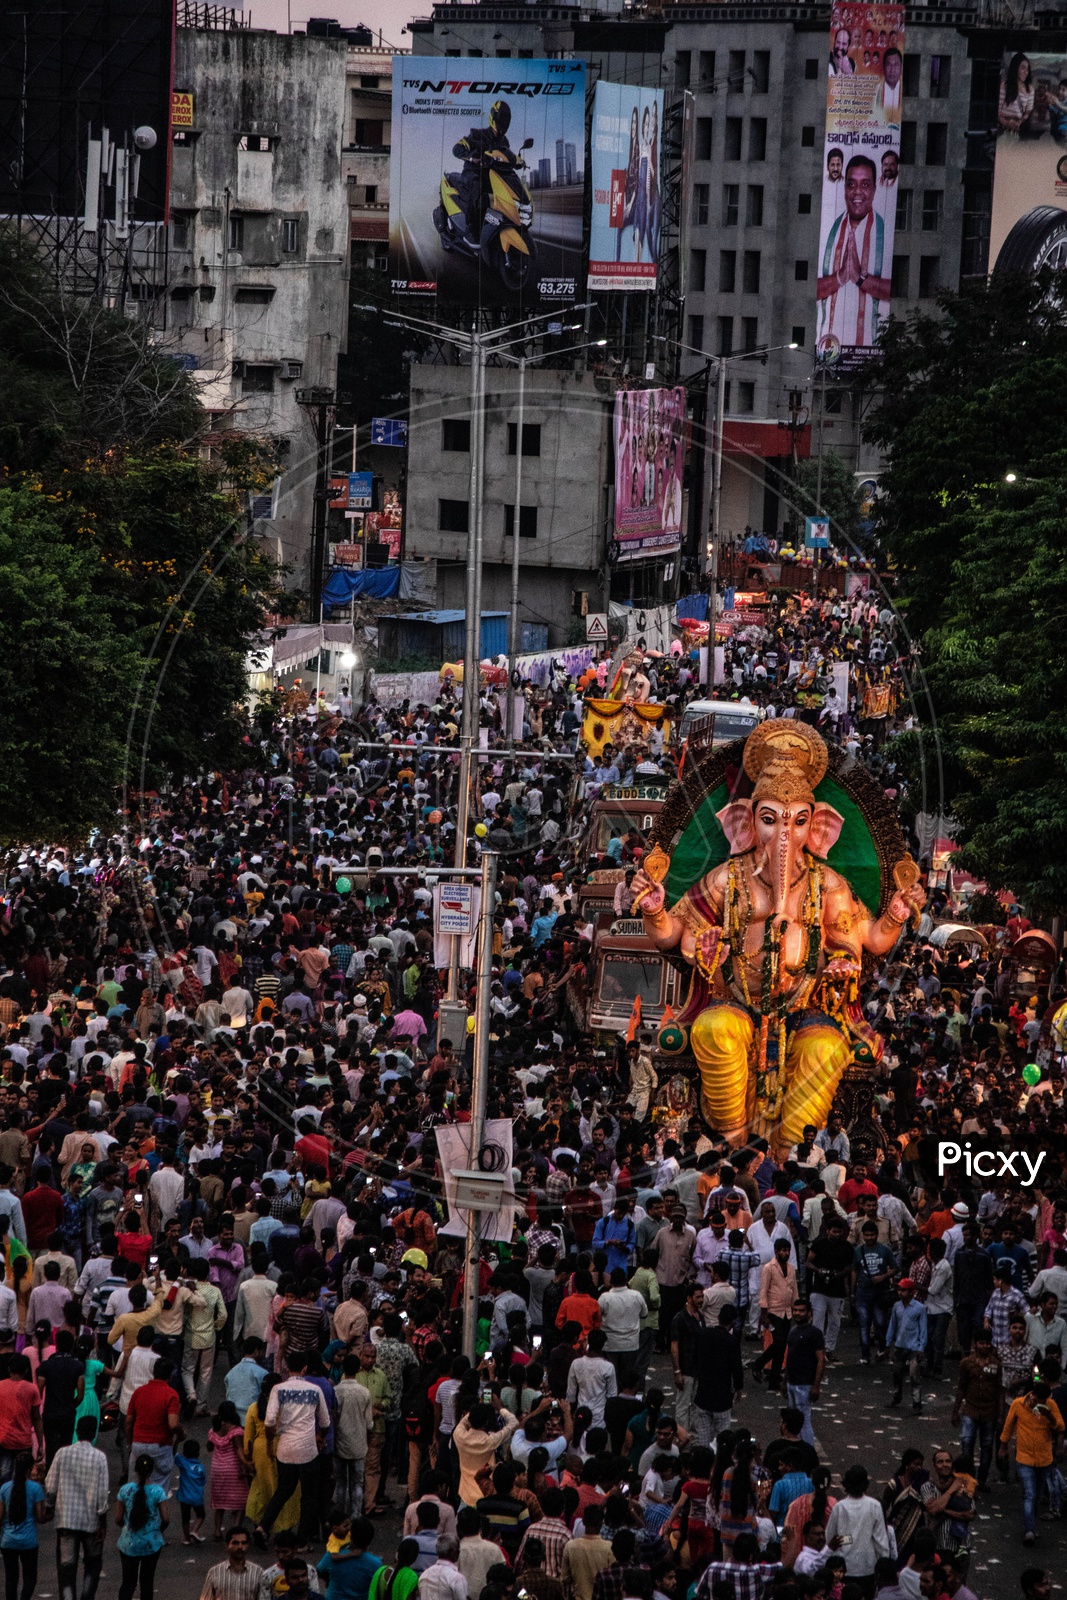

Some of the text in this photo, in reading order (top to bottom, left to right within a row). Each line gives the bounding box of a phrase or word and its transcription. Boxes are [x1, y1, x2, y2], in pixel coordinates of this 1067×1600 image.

[548, 65, 566, 73] TVS
[402, 80, 575, 98] TVS NTORQ 125
[408, 107, 432, 115] Bluetooth
[432, 108, 460, 116] CONNECTED
[1033, 235, 1051, 270] MRF
[390, 279, 408, 289] TVS
